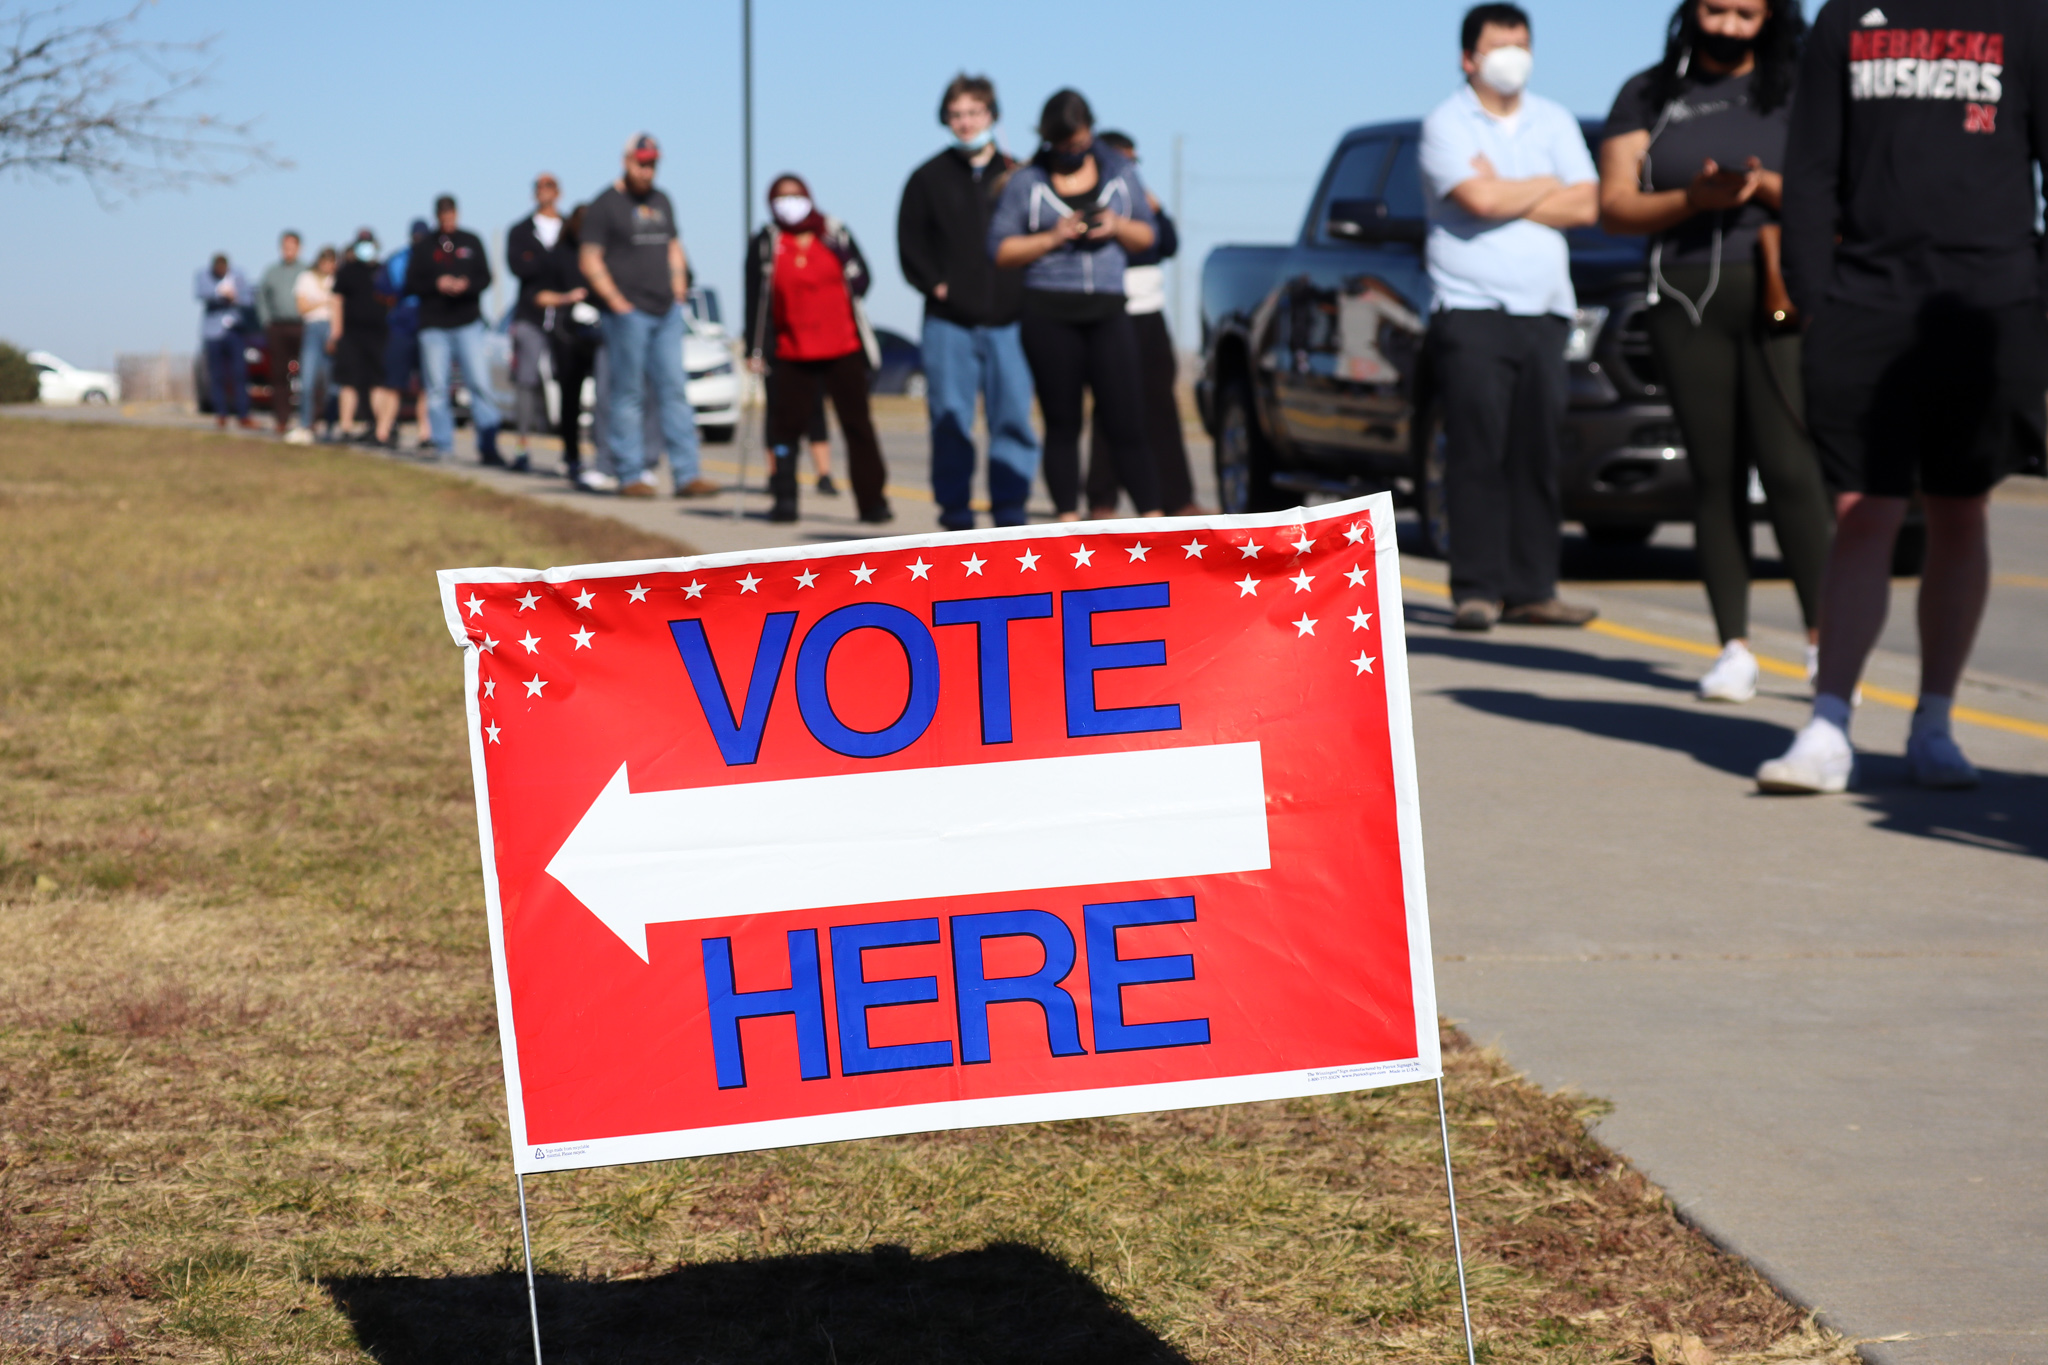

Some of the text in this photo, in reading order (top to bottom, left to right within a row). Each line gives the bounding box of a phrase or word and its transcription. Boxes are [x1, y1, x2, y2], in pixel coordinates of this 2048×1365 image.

[1849, 28, 2005, 66] NEBRASKA
[1849, 57, 2004, 103] HUSKERS
[1963, 103, 1998, 134] N
[667, 581, 1182, 766] VOTE
[701, 896, 1211, 1090] HERE
